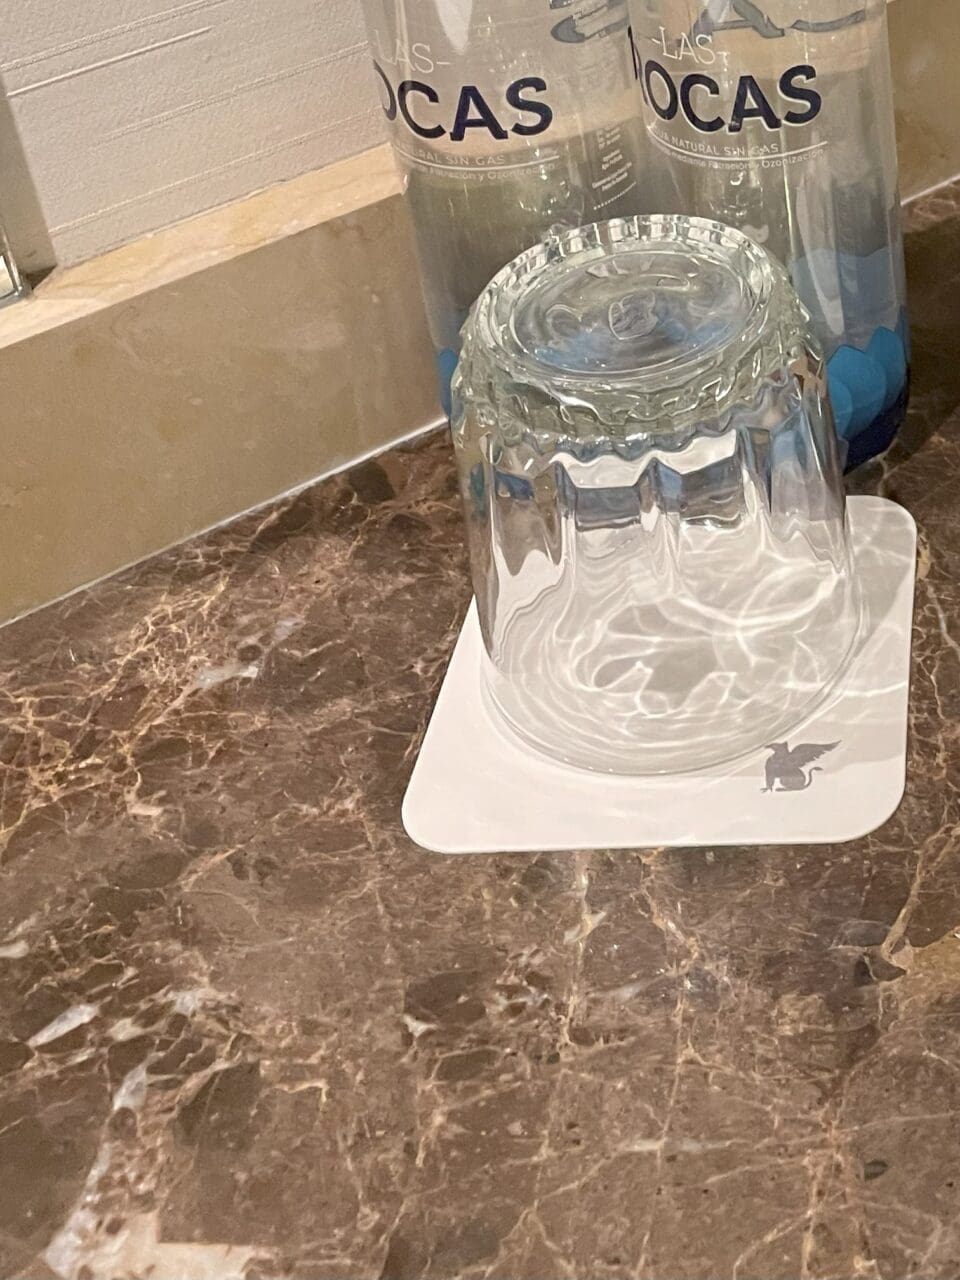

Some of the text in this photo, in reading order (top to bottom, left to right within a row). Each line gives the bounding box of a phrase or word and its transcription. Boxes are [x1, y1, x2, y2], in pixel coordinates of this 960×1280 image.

[672, 136, 720, 156] NATURAL
[752, 143, 779, 155] GAS
[476, 154, 506, 166] GAS
